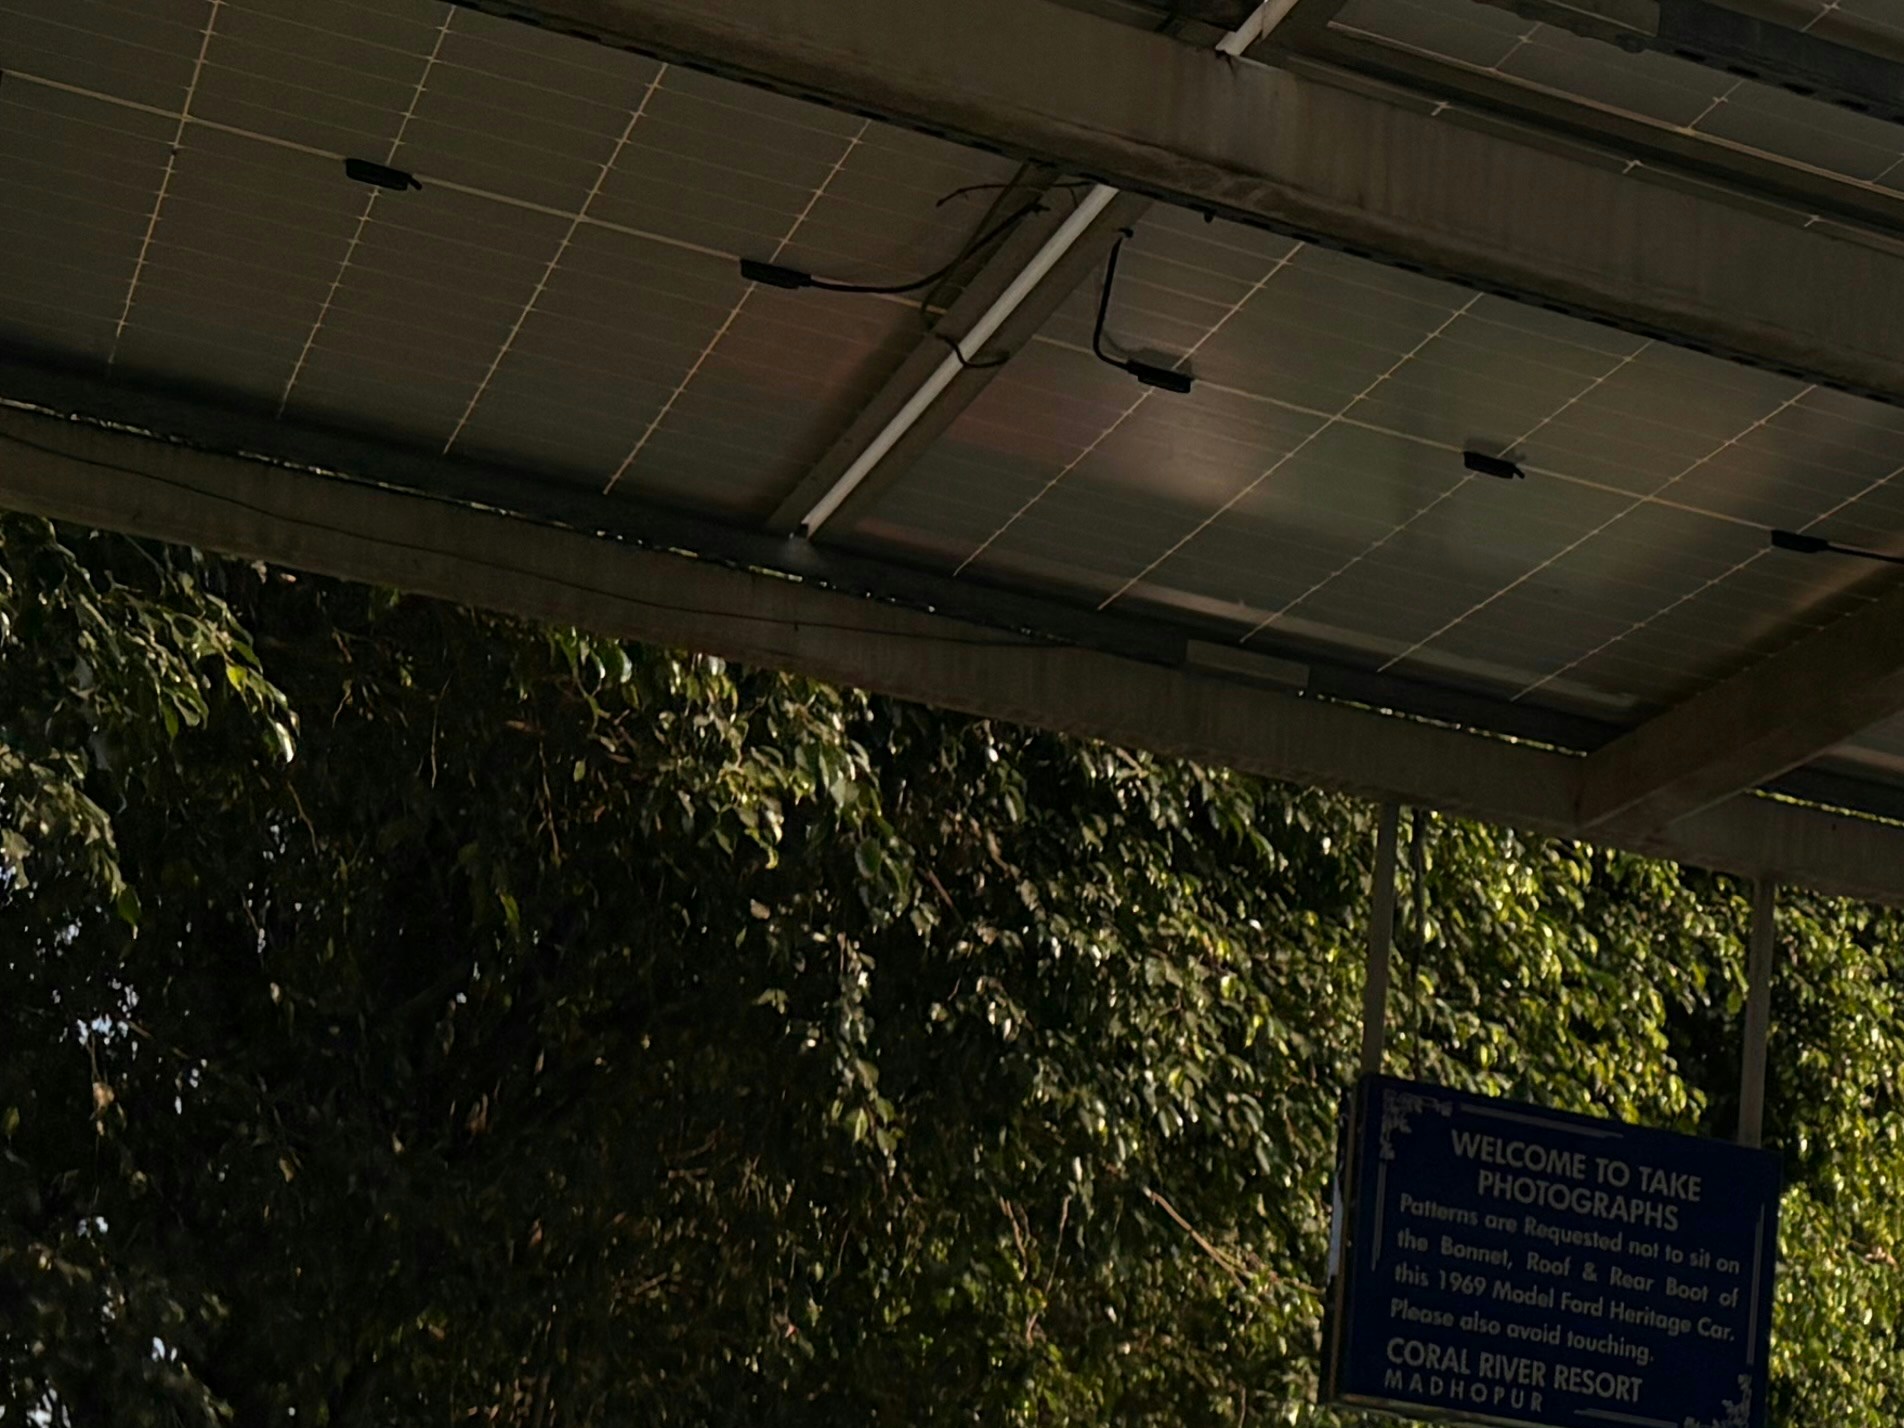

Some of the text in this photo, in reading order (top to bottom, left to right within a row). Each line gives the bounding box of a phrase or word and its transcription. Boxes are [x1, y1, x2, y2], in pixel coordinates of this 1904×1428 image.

[1451, 1129, 1702, 1203] WELCOME TO TAKE
[1477, 1169, 1680, 1232] PHOTOGRAPHS
[1397, 1227, 1740, 1308] the Bonnet, Roof & Rear Boot of
[1400, 1192, 1740, 1275] Patterns are Requested not to sit on
[1390, 1297, 1655, 1367] Please also avoid touching.
[1394, 1261, 1736, 1342] this 1969 Model Ford Heritage Car.
[1384, 1368, 1543, 1413] MADHOPUR
[1386, 1337, 1643, 1404] CORAL RIVER RESORT
